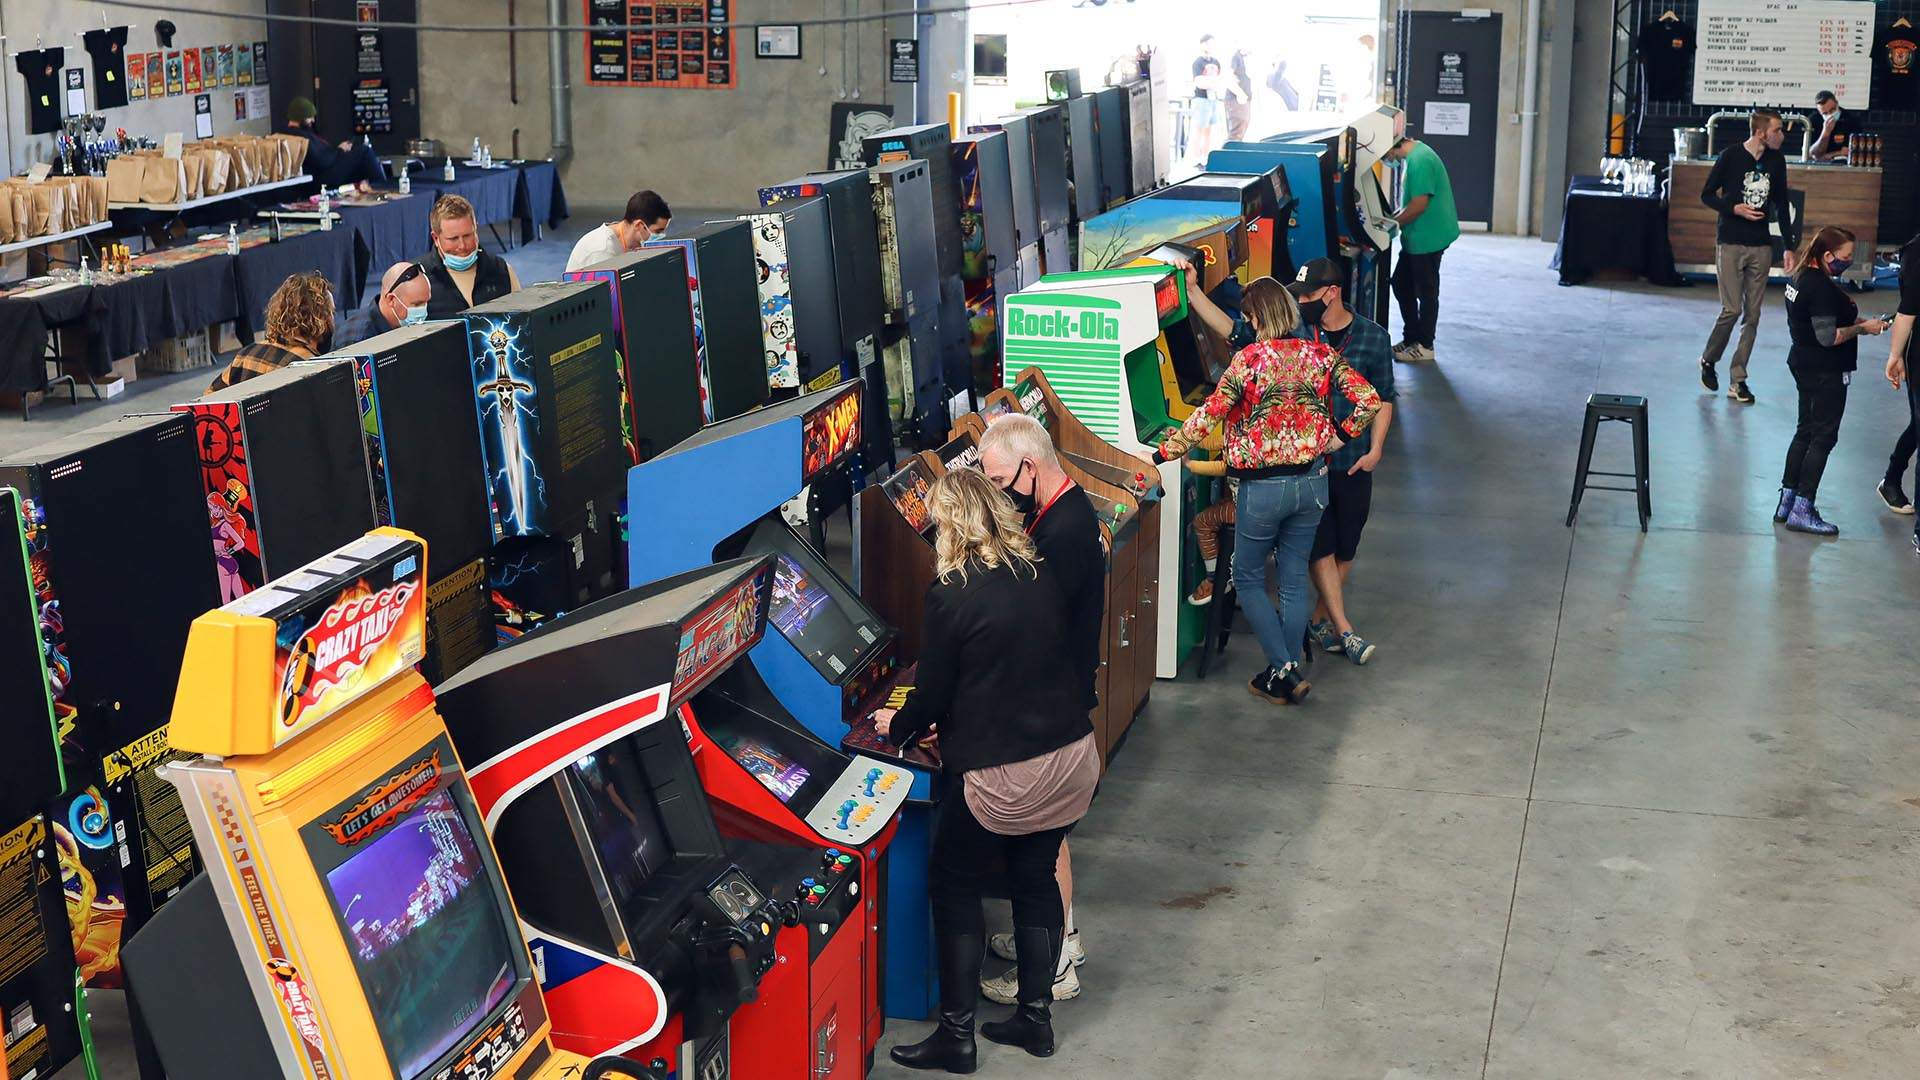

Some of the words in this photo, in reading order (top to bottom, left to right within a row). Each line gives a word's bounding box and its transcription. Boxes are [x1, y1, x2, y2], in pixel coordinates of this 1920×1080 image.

[881, 141, 905, 151] SEGA
[1008, 307, 1119, 340] Rock-Ola
[393, 555, 417, 581] SEGA
[315, 620, 361, 672] CRAZY
[360, 604, 391, 646] TAXI
[131, 726, 170, 756] ATTEN
[345, 811, 369, 836] LET'S
[370, 800, 387, 819] GET
[244, 874, 259, 897] FEEL
[252, 896, 266, 917] THE
[285, 981, 307, 1013] CRAZY
